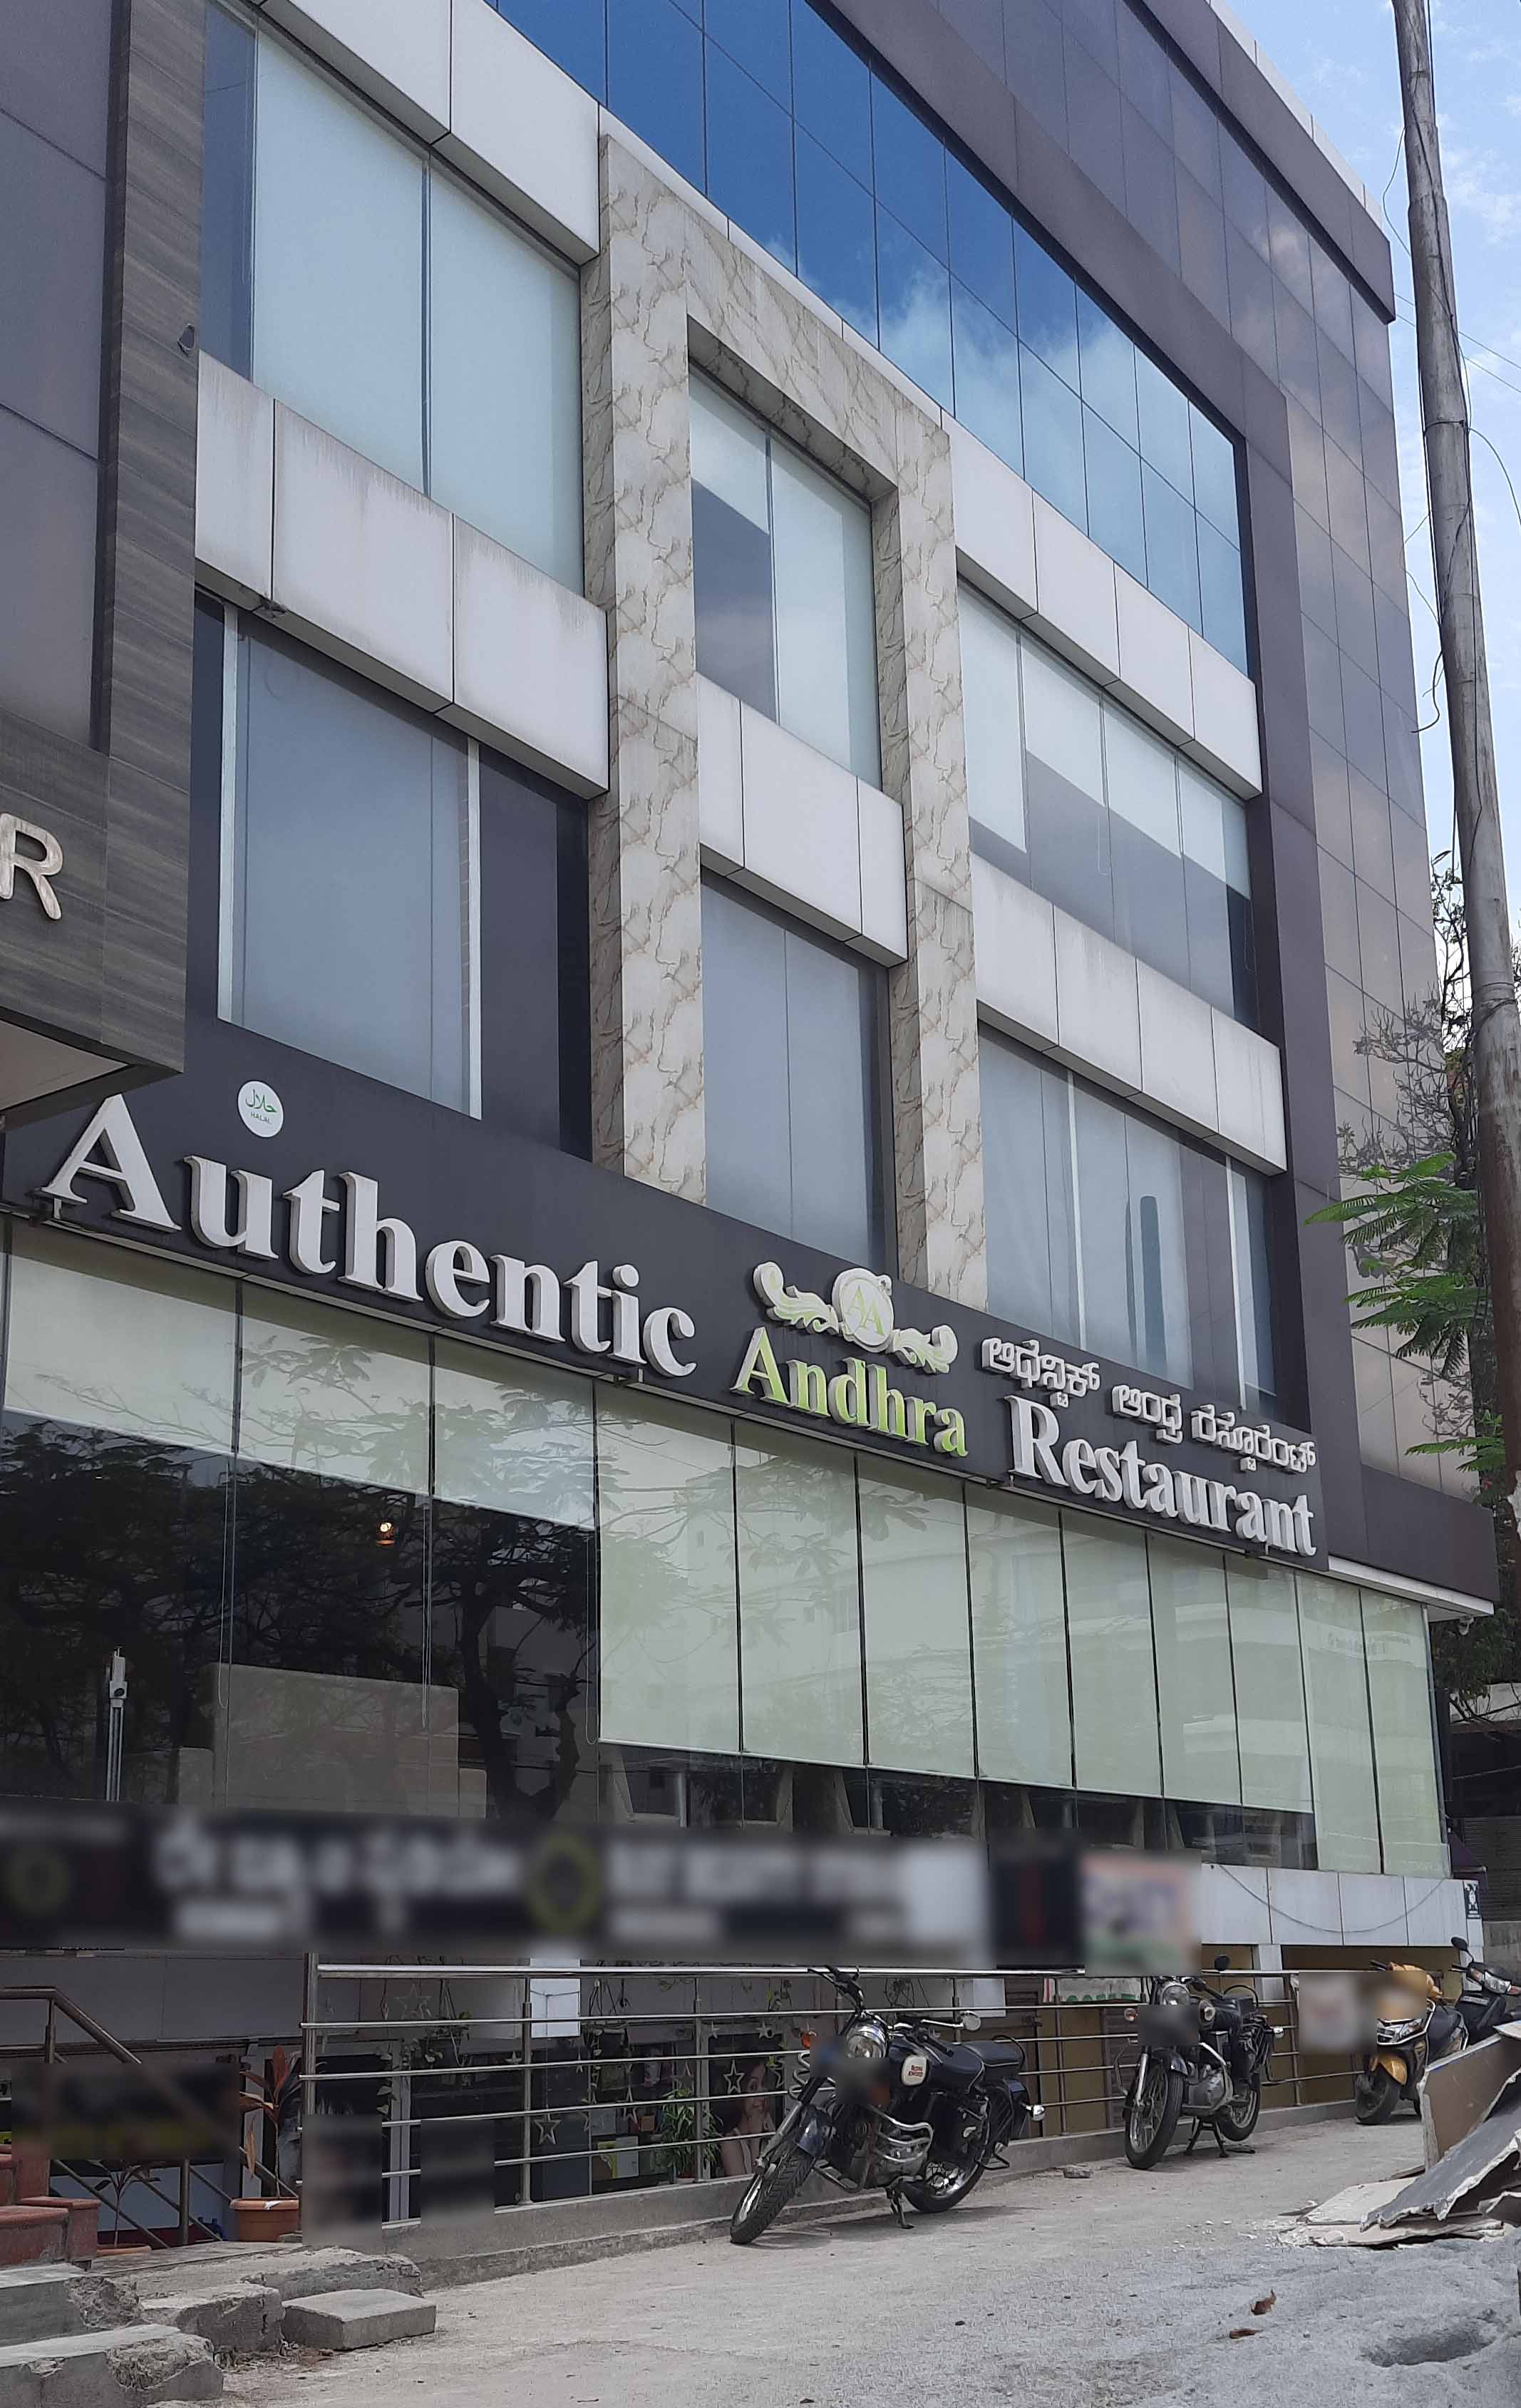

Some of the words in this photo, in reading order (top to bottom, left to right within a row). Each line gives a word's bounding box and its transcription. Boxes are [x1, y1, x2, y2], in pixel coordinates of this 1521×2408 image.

[0, 813, 63, 920] R
[246, 1089, 277, 1113] حلال
[250, 1111, 271, 1124] HALAL
[37, 1094, 697, 1377] Authentic
[730, 1327, 968, 1456] Andhra
[1004, 1396, 1316, 1556] Restaurant
